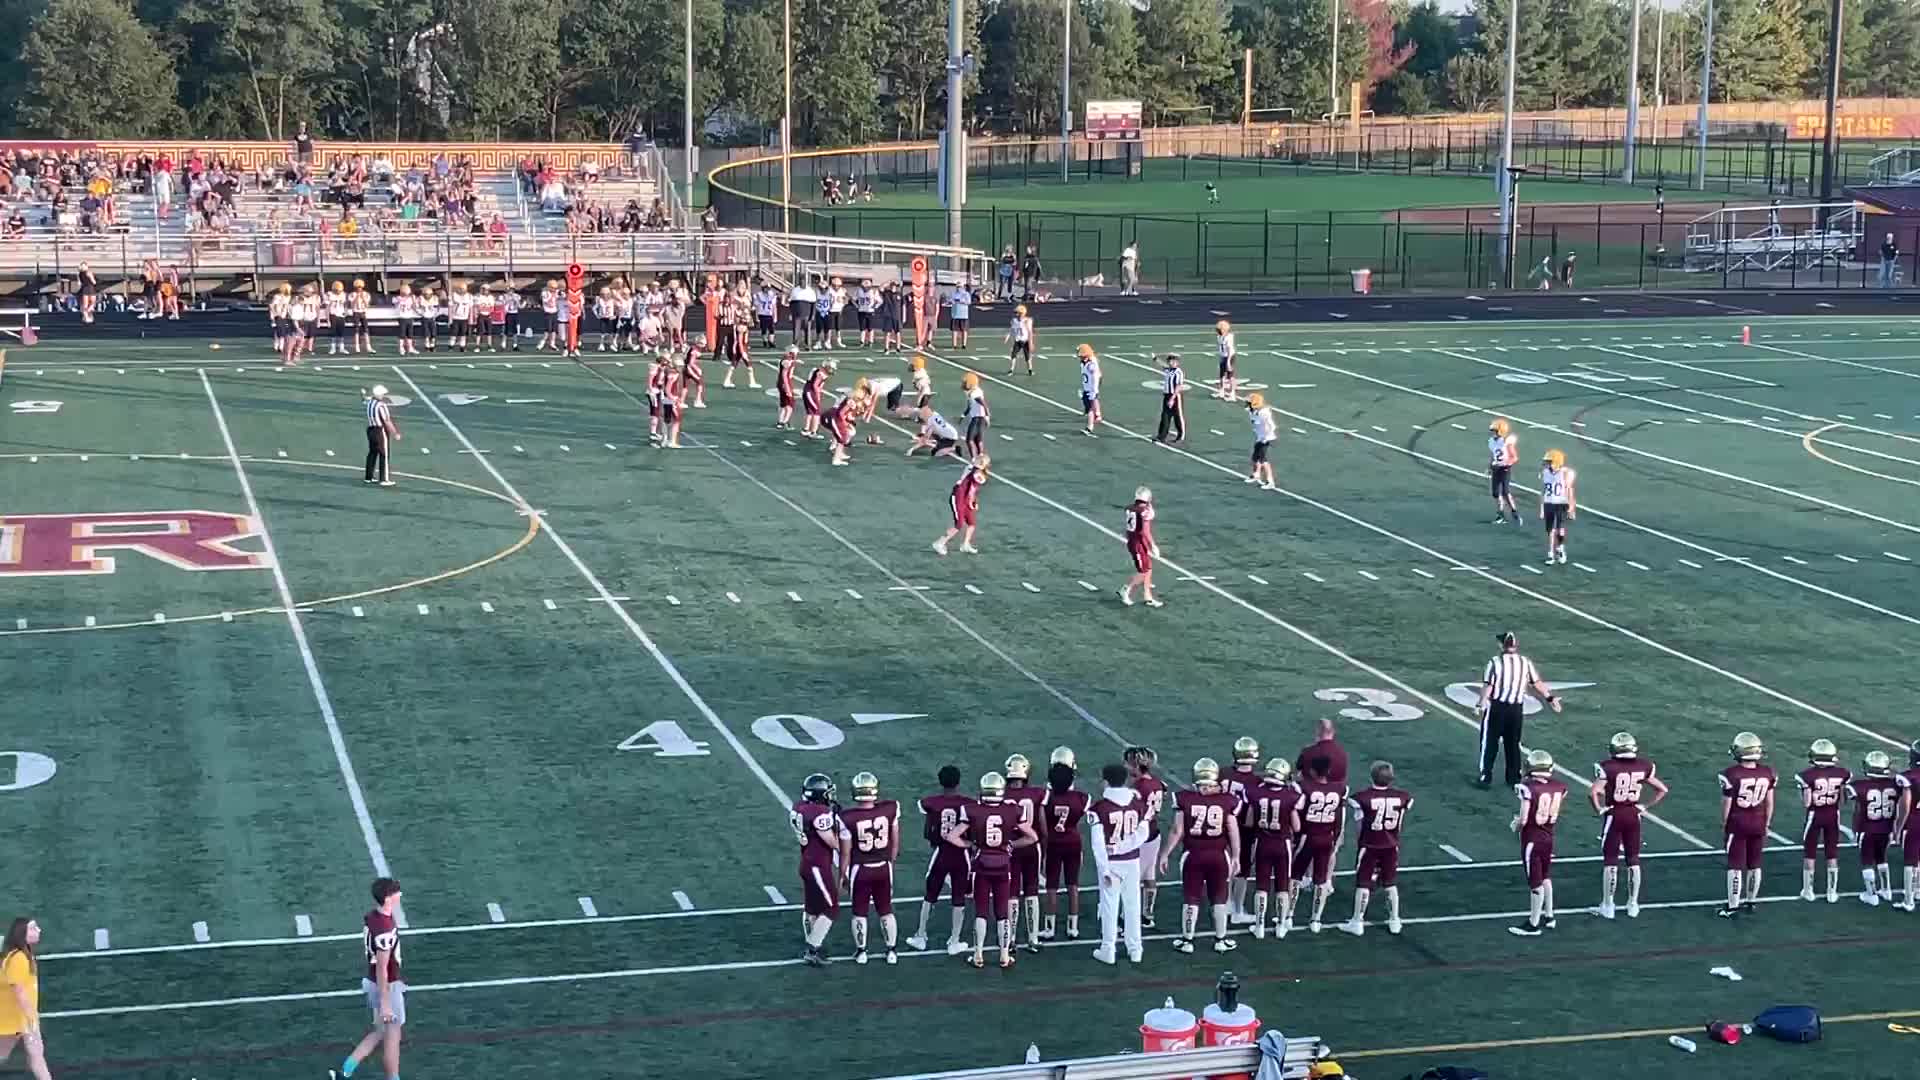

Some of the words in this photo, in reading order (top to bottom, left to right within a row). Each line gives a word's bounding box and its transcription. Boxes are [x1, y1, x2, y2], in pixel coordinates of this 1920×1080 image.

[1796, 115, 1894, 136] SPRTANS
[1613, 771, 1646, 803] 85
[1736, 777, 1771, 808] 50
[1812, 778, 1844, 807] 25
[1053, 805, 1071, 833] 7
[1189, 804, 1224, 837] 79
[1257, 798, 1282, 830] 11
[1305, 791, 1341, 824] 22
[1370, 797, 1403, 832] 75
[1866, 788, 1897, 821] 26
[856, 815, 890, 852] 53
[985, 814, 1004, 848] 6
[1109, 809, 1139, 845] 70
